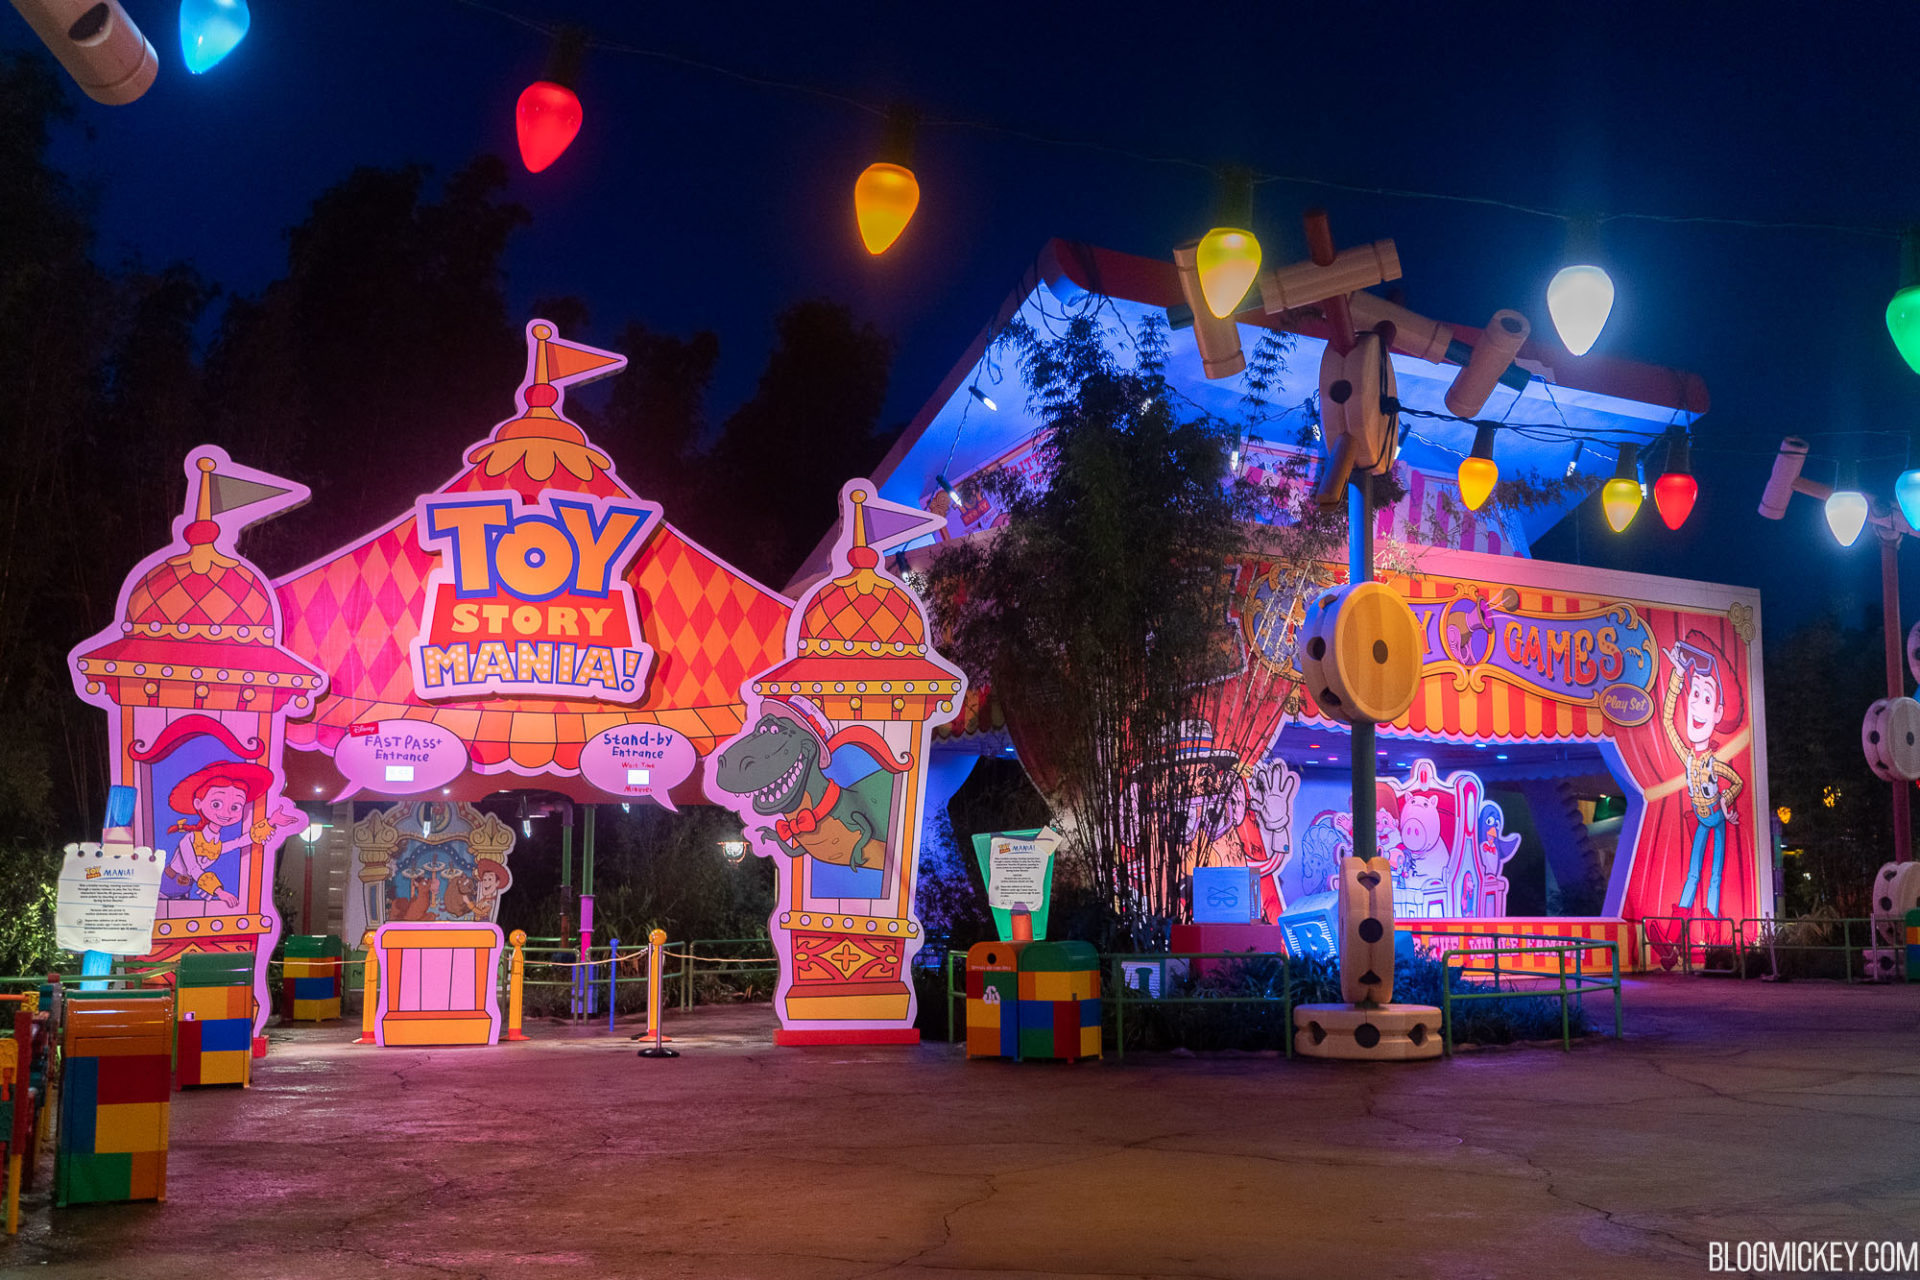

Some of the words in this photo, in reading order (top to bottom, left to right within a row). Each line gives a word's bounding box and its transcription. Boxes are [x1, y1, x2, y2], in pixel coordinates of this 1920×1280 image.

[426, 497, 653, 602] TOY
[451, 604, 613, 636] STORY
[1504, 621, 1625, 685] GAMES
[420, 640, 643, 692] MANIA!
[1604, 695, 1629, 712] Play
[1630, 697, 1647, 711] Set
[351, 725, 376, 734] Disney
[603, 731, 673, 746] Stand-by
[375, 749, 430, 762] Entrance
[612, 746, 664, 759] Entrance
